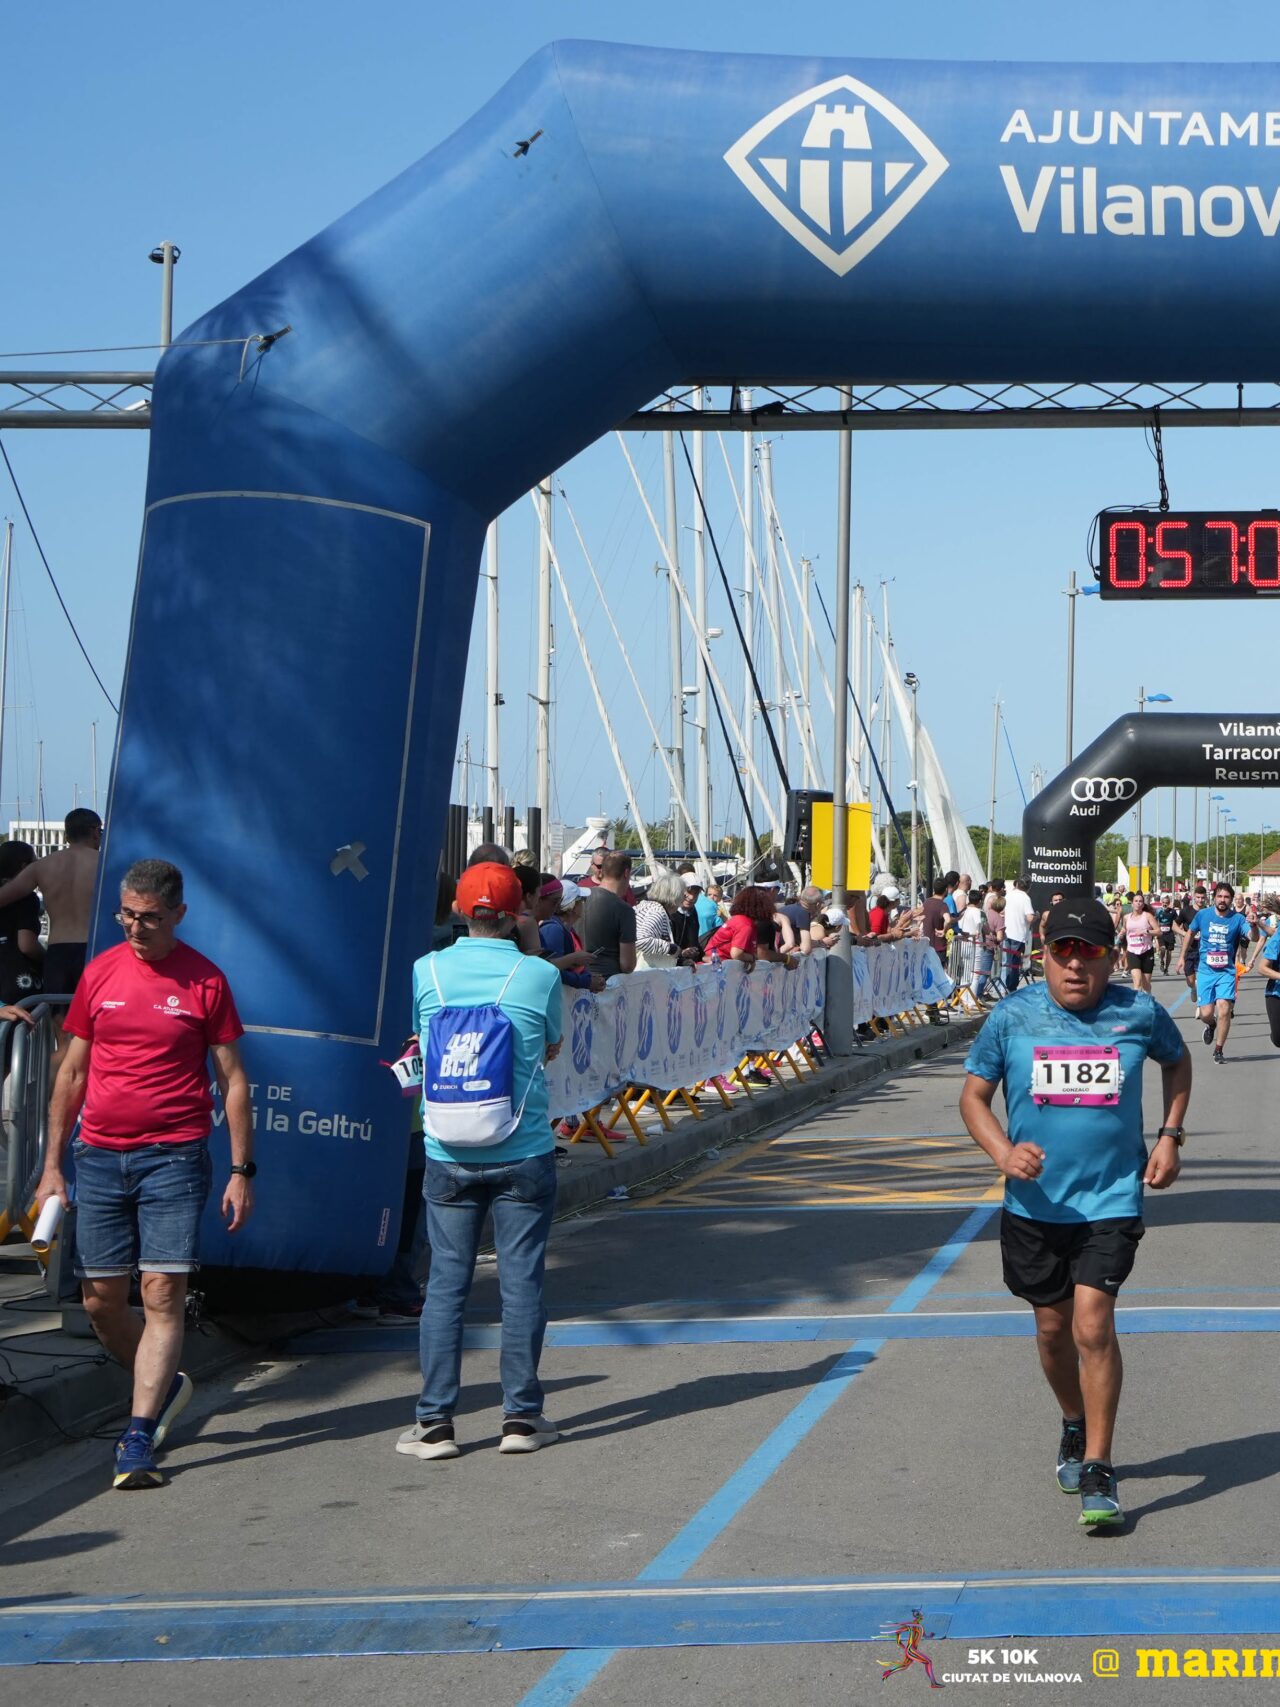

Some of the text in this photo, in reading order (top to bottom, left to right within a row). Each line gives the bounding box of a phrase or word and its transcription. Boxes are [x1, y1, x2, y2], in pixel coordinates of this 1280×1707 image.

[1069, 805, 1100, 817] Audi
[1033, 846, 1082, 858] Vilamòbil
[1027, 859, 1088, 871] Tarracomòbil
[1031, 872, 1083, 884] Reusmòbil
[1042, 1062, 1111, 1084] 1182
[267, 1085, 292, 1101] DE
[266, 1107, 290, 1132] la
[298, 1110, 372, 1141] Geltrú
